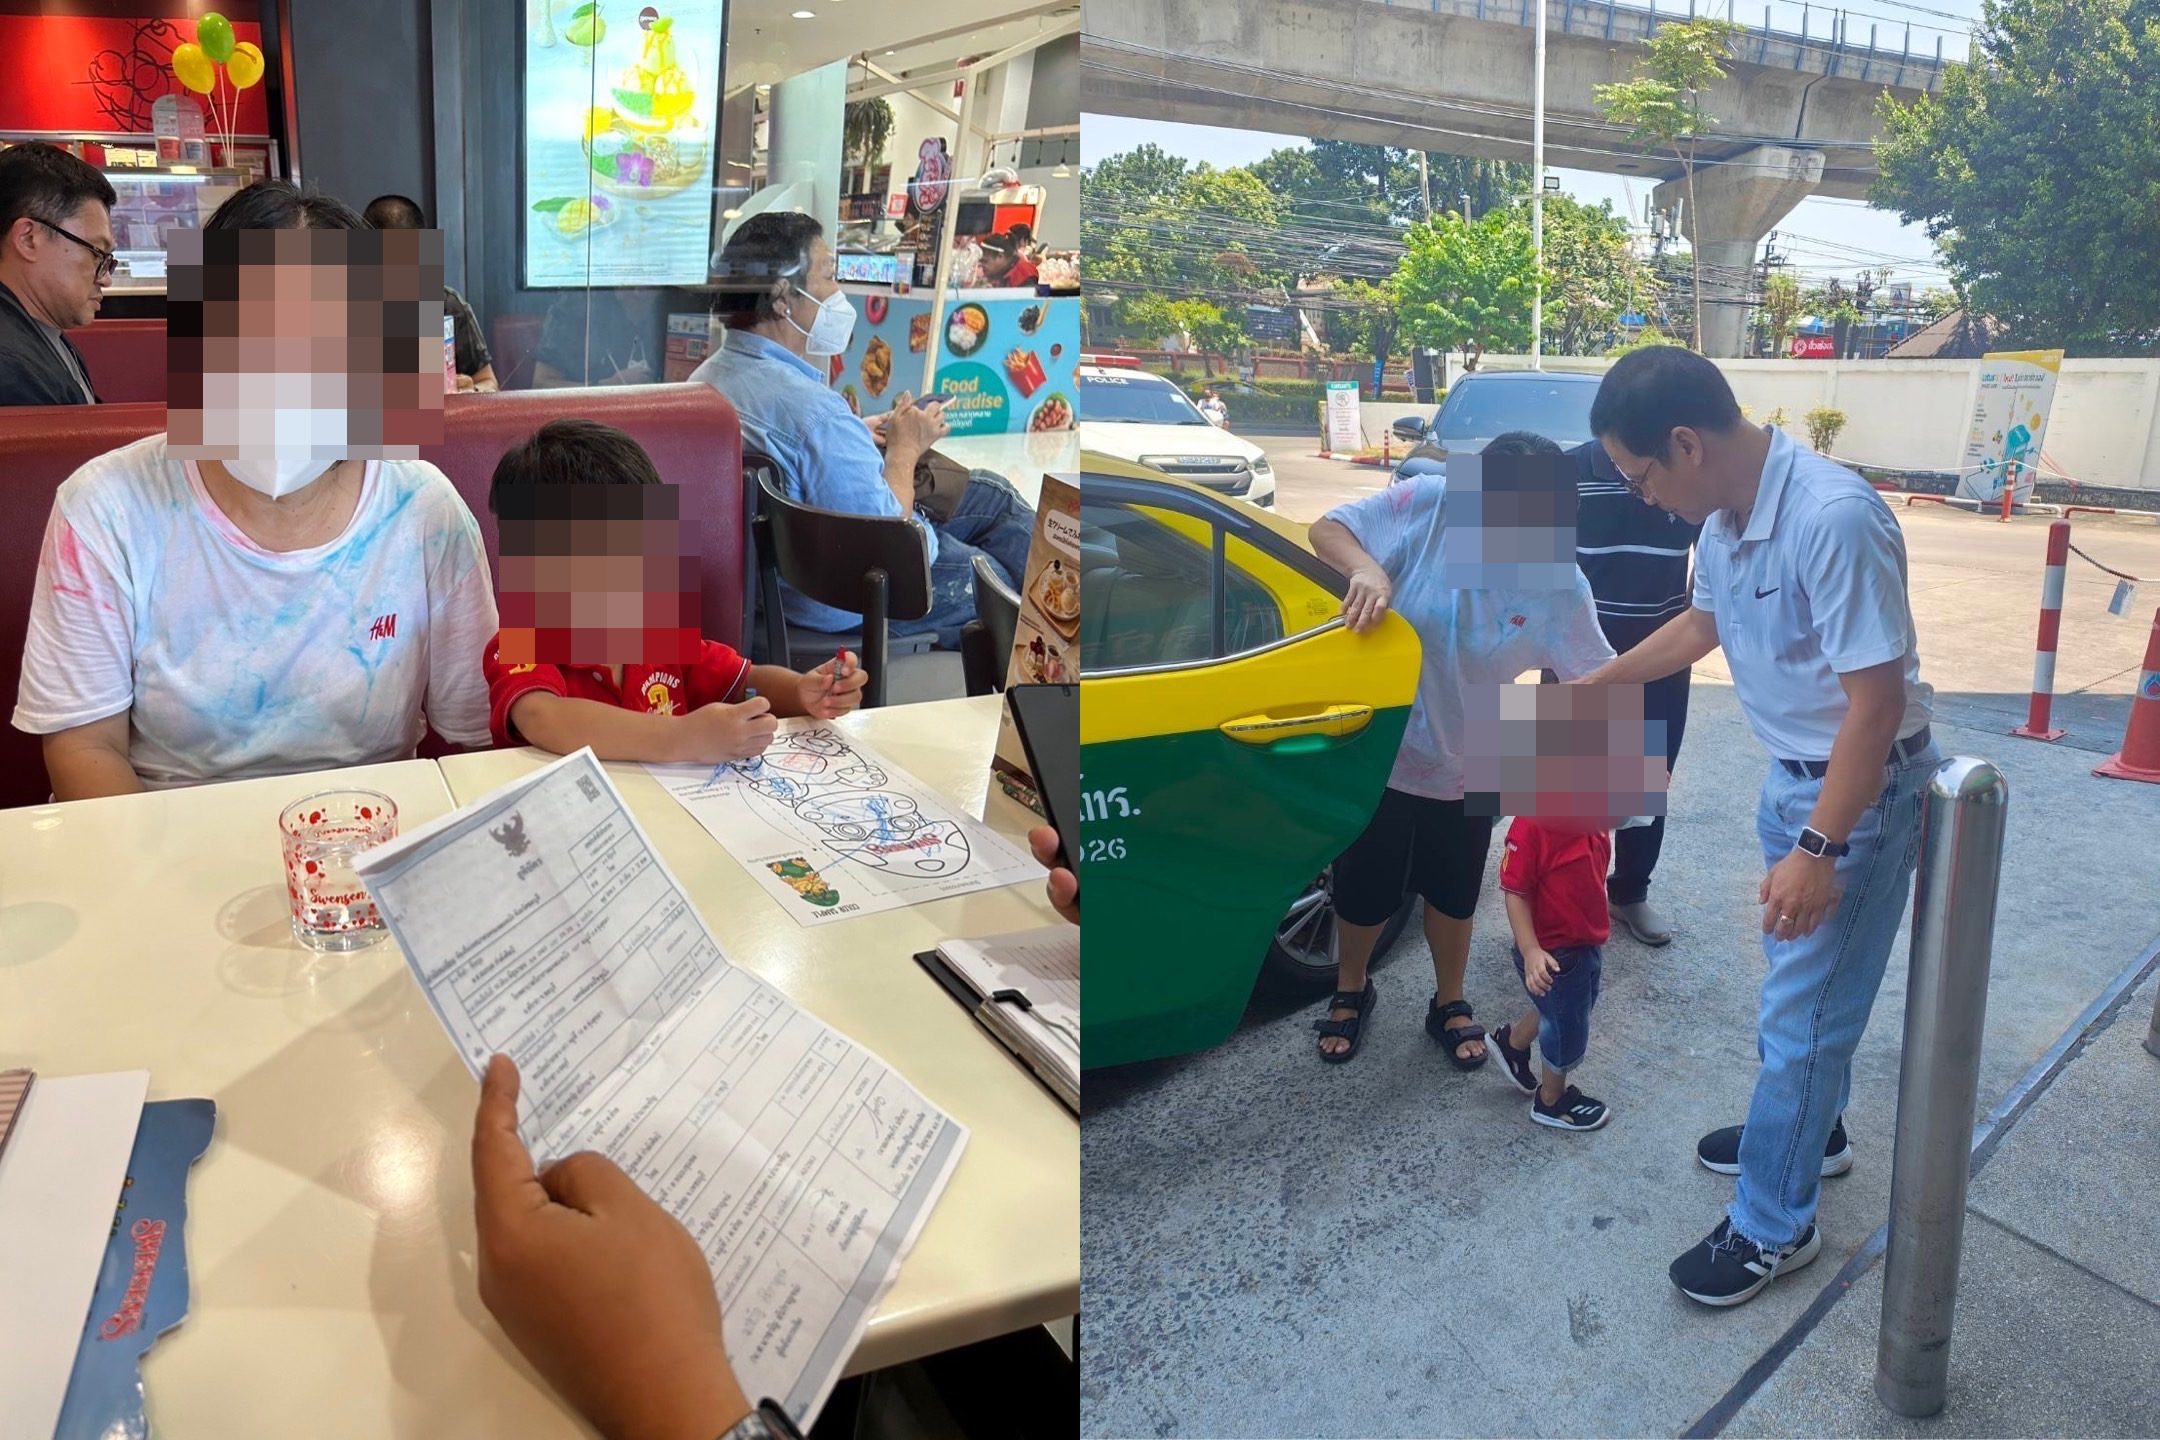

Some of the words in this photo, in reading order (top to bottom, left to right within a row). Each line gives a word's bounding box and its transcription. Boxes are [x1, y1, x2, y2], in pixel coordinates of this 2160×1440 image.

[941, 376, 979, 394] Food
[1086, 376, 1129, 385] POLICE
[946, 392, 1003, 410] aradise
[369, 613, 397, 641] H&M
[1080, 837, 1127, 863] 26
